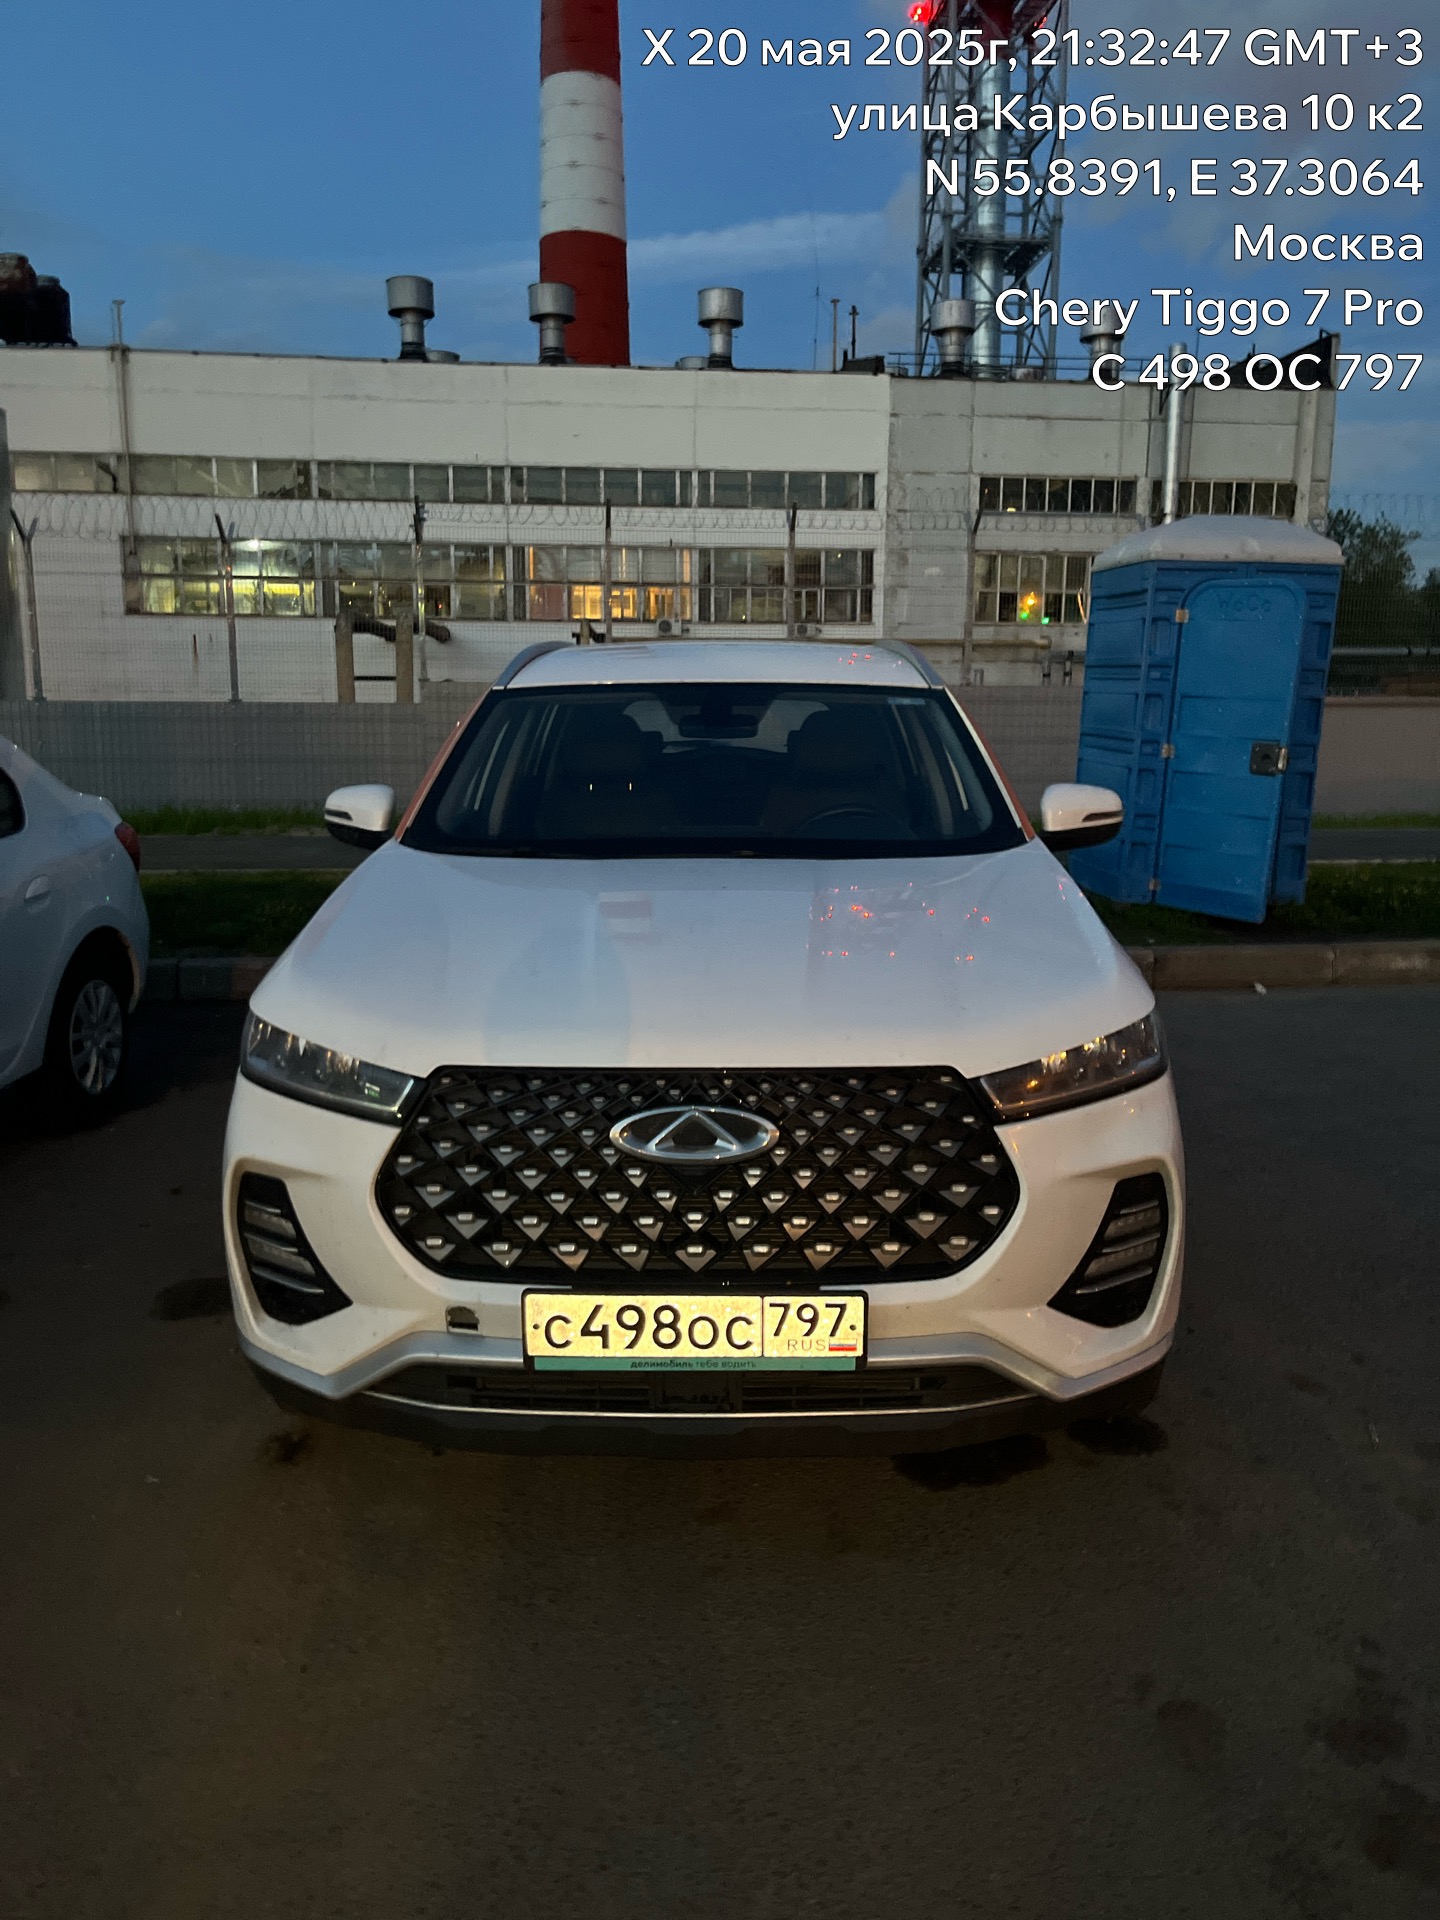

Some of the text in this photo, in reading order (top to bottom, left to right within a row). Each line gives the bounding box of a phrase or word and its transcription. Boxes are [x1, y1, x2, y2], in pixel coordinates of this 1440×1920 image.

[768, 1302, 849, 1338] 797
[786, 1338, 827, 1352] RUS
[630, 1359, 757, 1369] делимобиль тебе водить
